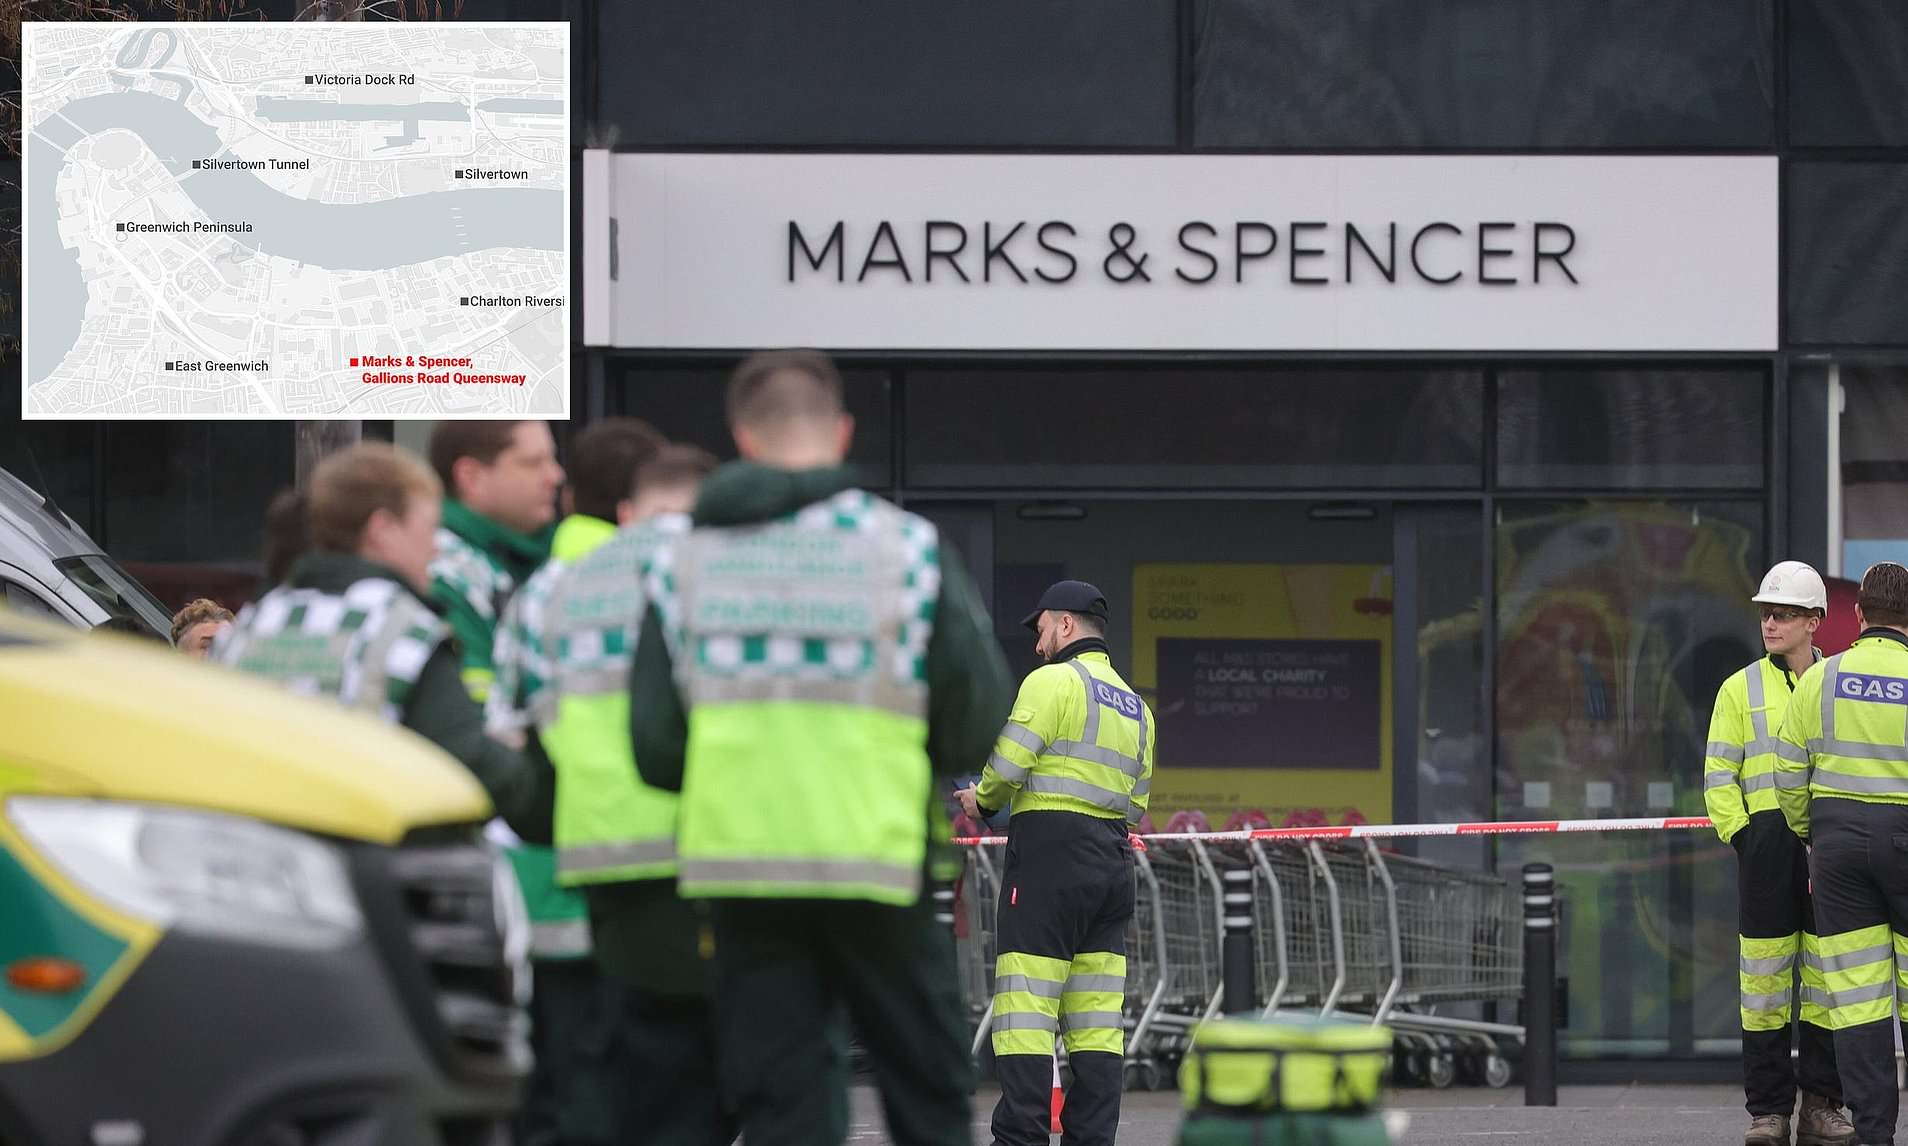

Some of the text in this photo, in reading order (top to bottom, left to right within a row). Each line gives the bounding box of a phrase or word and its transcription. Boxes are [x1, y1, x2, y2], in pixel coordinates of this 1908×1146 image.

[787, 220, 1580, 287] MARKS & SPENCER
[1147, 607, 1199, 621] GOOD
[1208, 668, 1257, 683] LOCAL
[1262, 668, 1328, 683] CHARITY
[1096, 683, 1139, 715] GAS
[1841, 676, 1905, 699] GAS
